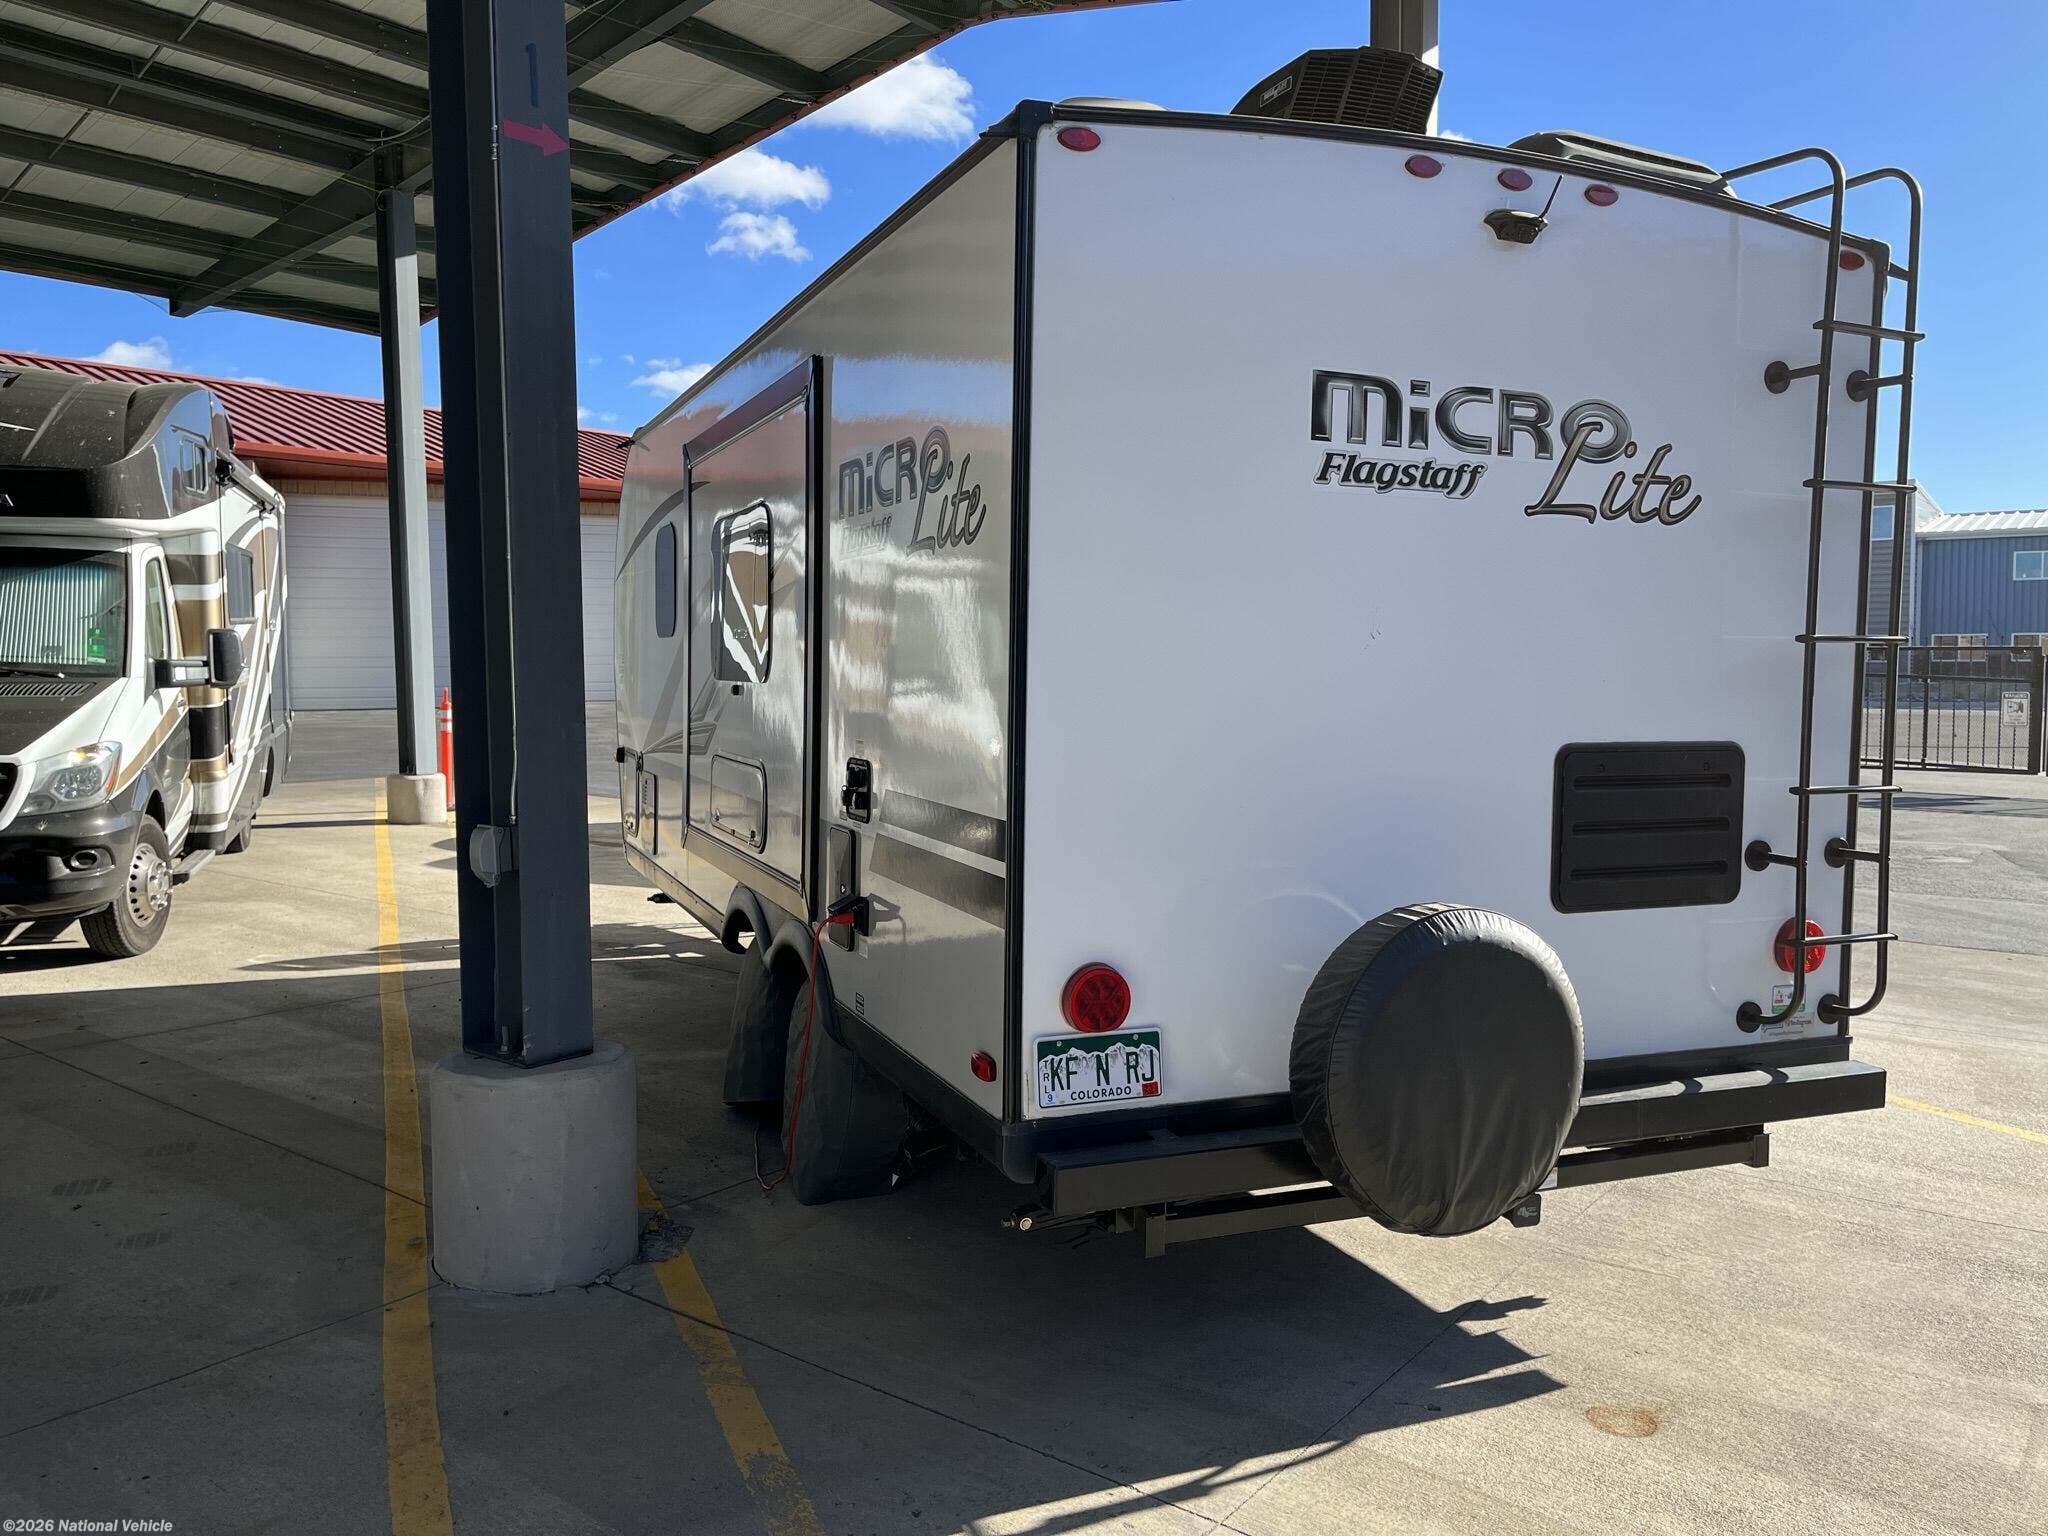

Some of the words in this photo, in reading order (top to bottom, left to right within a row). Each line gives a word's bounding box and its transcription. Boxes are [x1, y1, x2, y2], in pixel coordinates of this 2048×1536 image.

[1314, 449, 1488, 500] Flagstaff
[1524, 421, 1702, 526] Lite
[906, 448, 987, 556] Lite
[1050, 1055, 1078, 1092] KF
[1095, 1052, 1110, 1087] N
[1125, 1048, 1155, 1084] RJ
[1070, 1085, 1132, 1101] COLORADO
